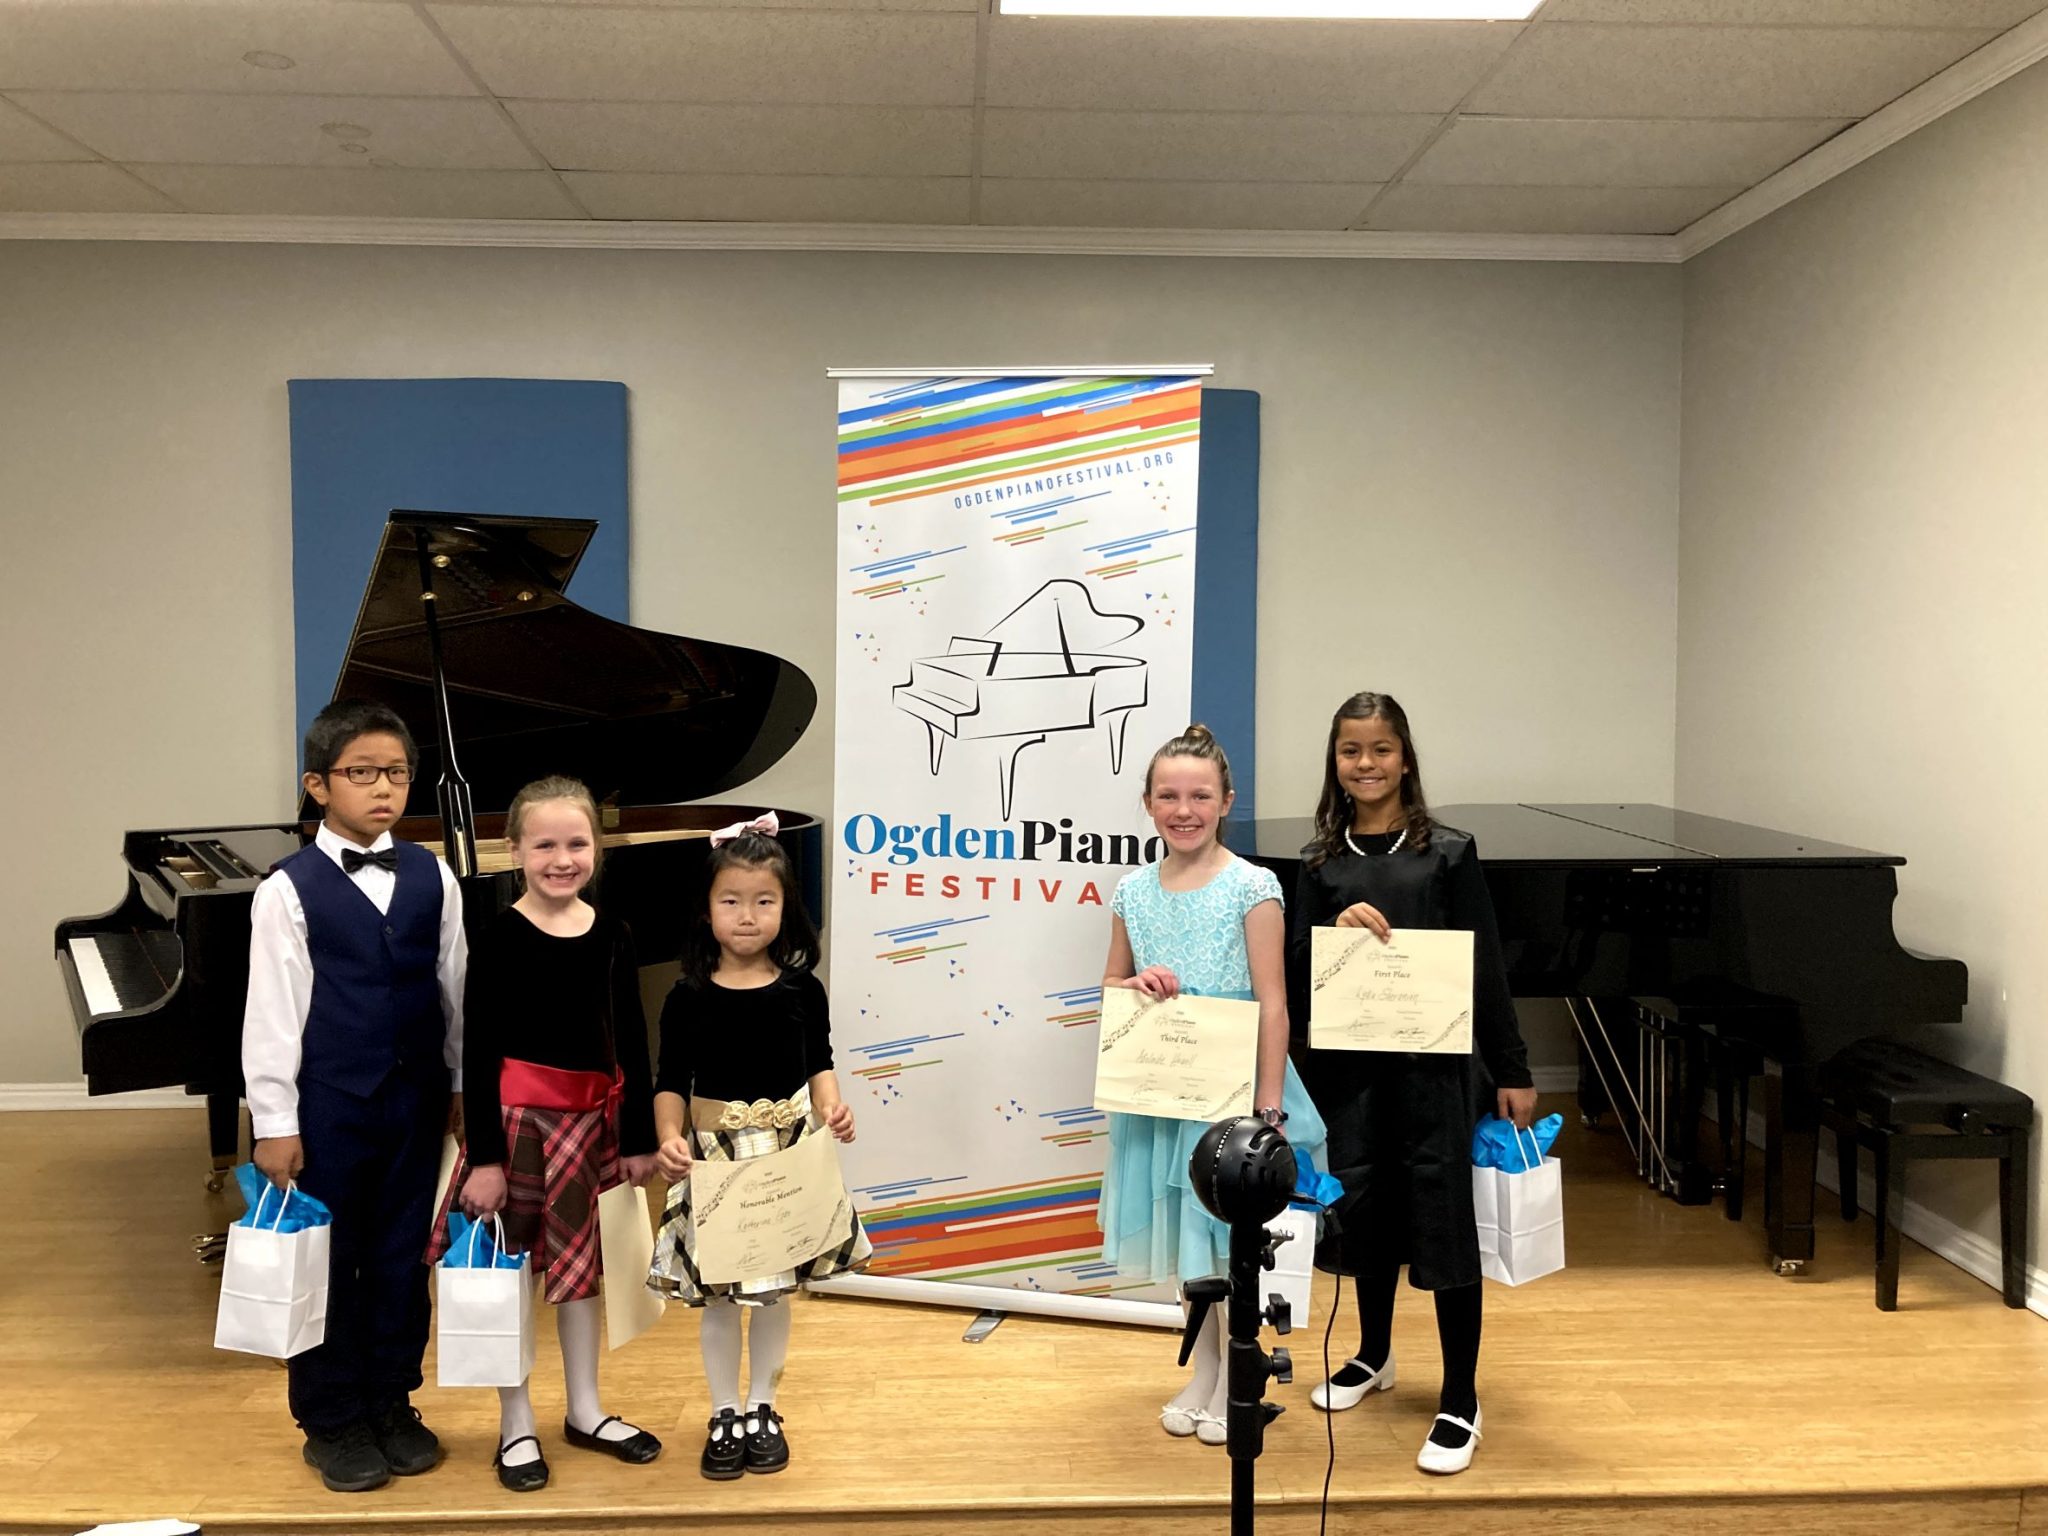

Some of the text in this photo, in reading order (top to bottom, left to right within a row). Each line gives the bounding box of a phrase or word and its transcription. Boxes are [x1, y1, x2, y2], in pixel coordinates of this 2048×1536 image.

[954, 451, 1175, 510] OGDENPIANOFESTIVAL.ORG
[870, 872, 1103, 906] FESTIVA
[1374, 970, 1411, 978] First Place
[1160, 1034, 1198, 1045] Third Place
[739, 1195, 775, 1209] Honorable
[777, 1186, 803, 1200] Mention
